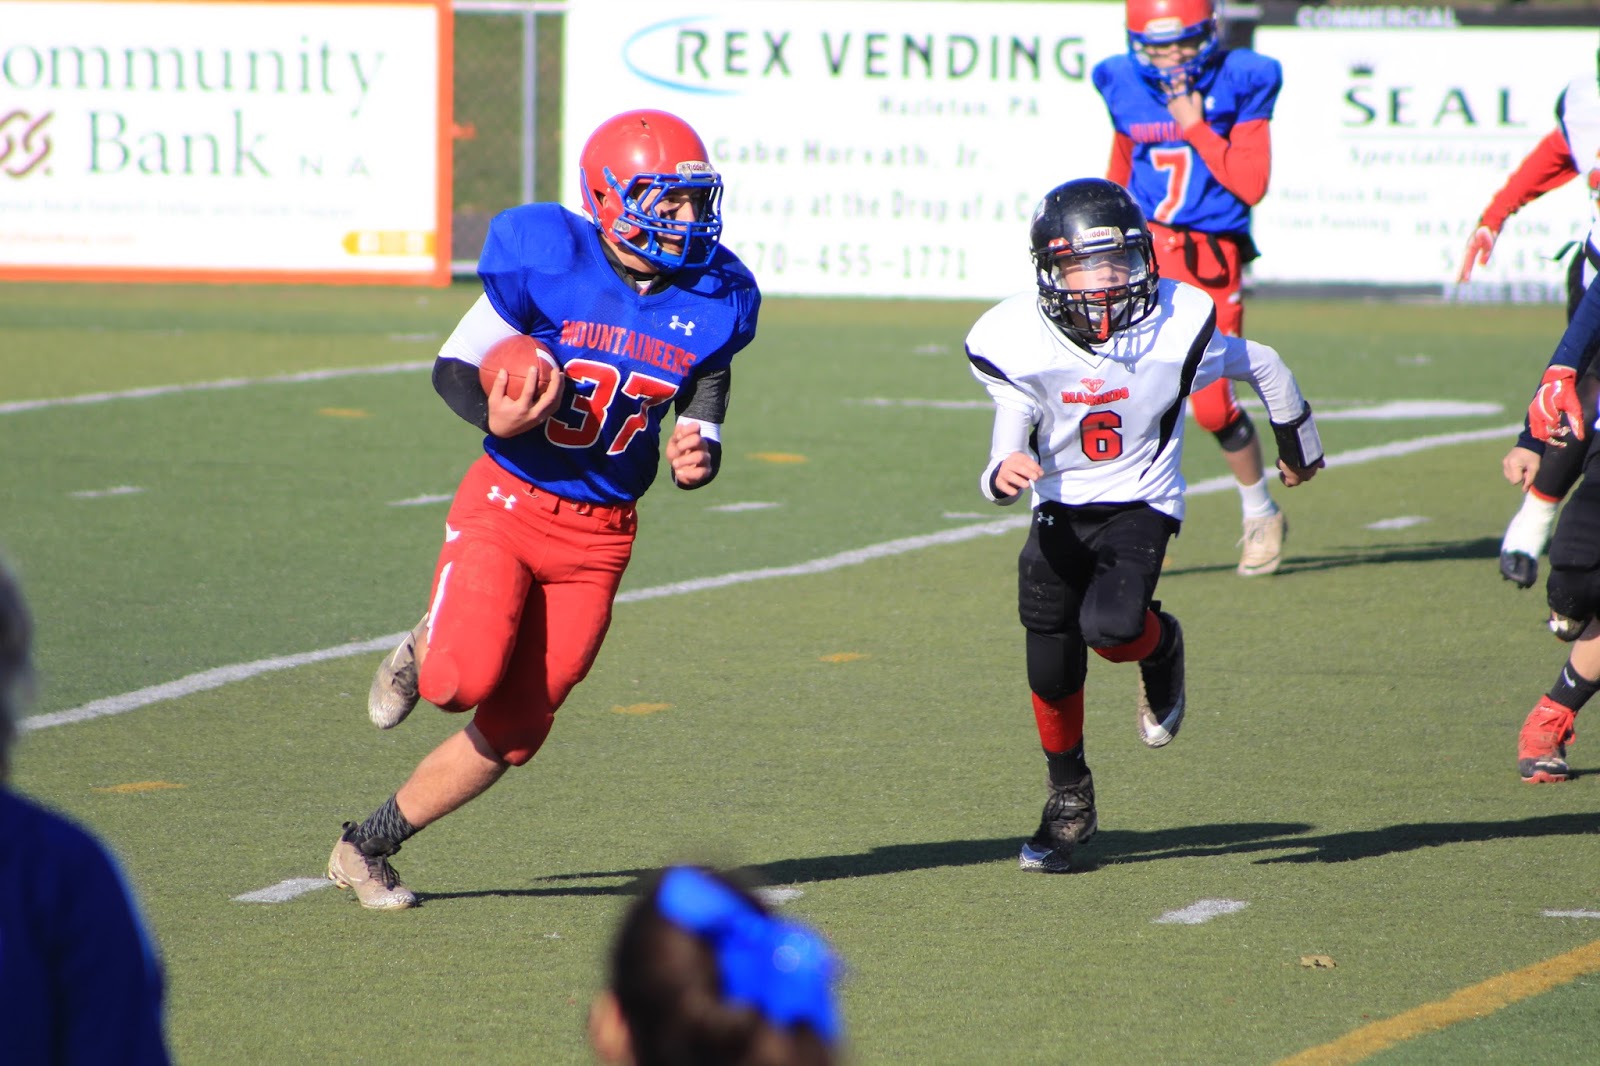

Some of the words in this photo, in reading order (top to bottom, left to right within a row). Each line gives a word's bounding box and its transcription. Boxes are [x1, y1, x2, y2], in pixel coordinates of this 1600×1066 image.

[2, 35, 385, 118] ommunity
[677, 31, 792, 80] REX
[822, 32, 1088, 82] VENDING
[1343, 85, 1528, 127] SEAL
[88, 108, 271, 177] Bank
[1149, 145, 1193, 224] 7
[1083, 228, 1111, 240] Riddell
[559, 319, 697, 377] MOUNTAINEERS
[545, 358, 680, 455] 37
[1060, 386, 1130, 406] DIAMONDS
[1080, 409, 1123, 461] 6
